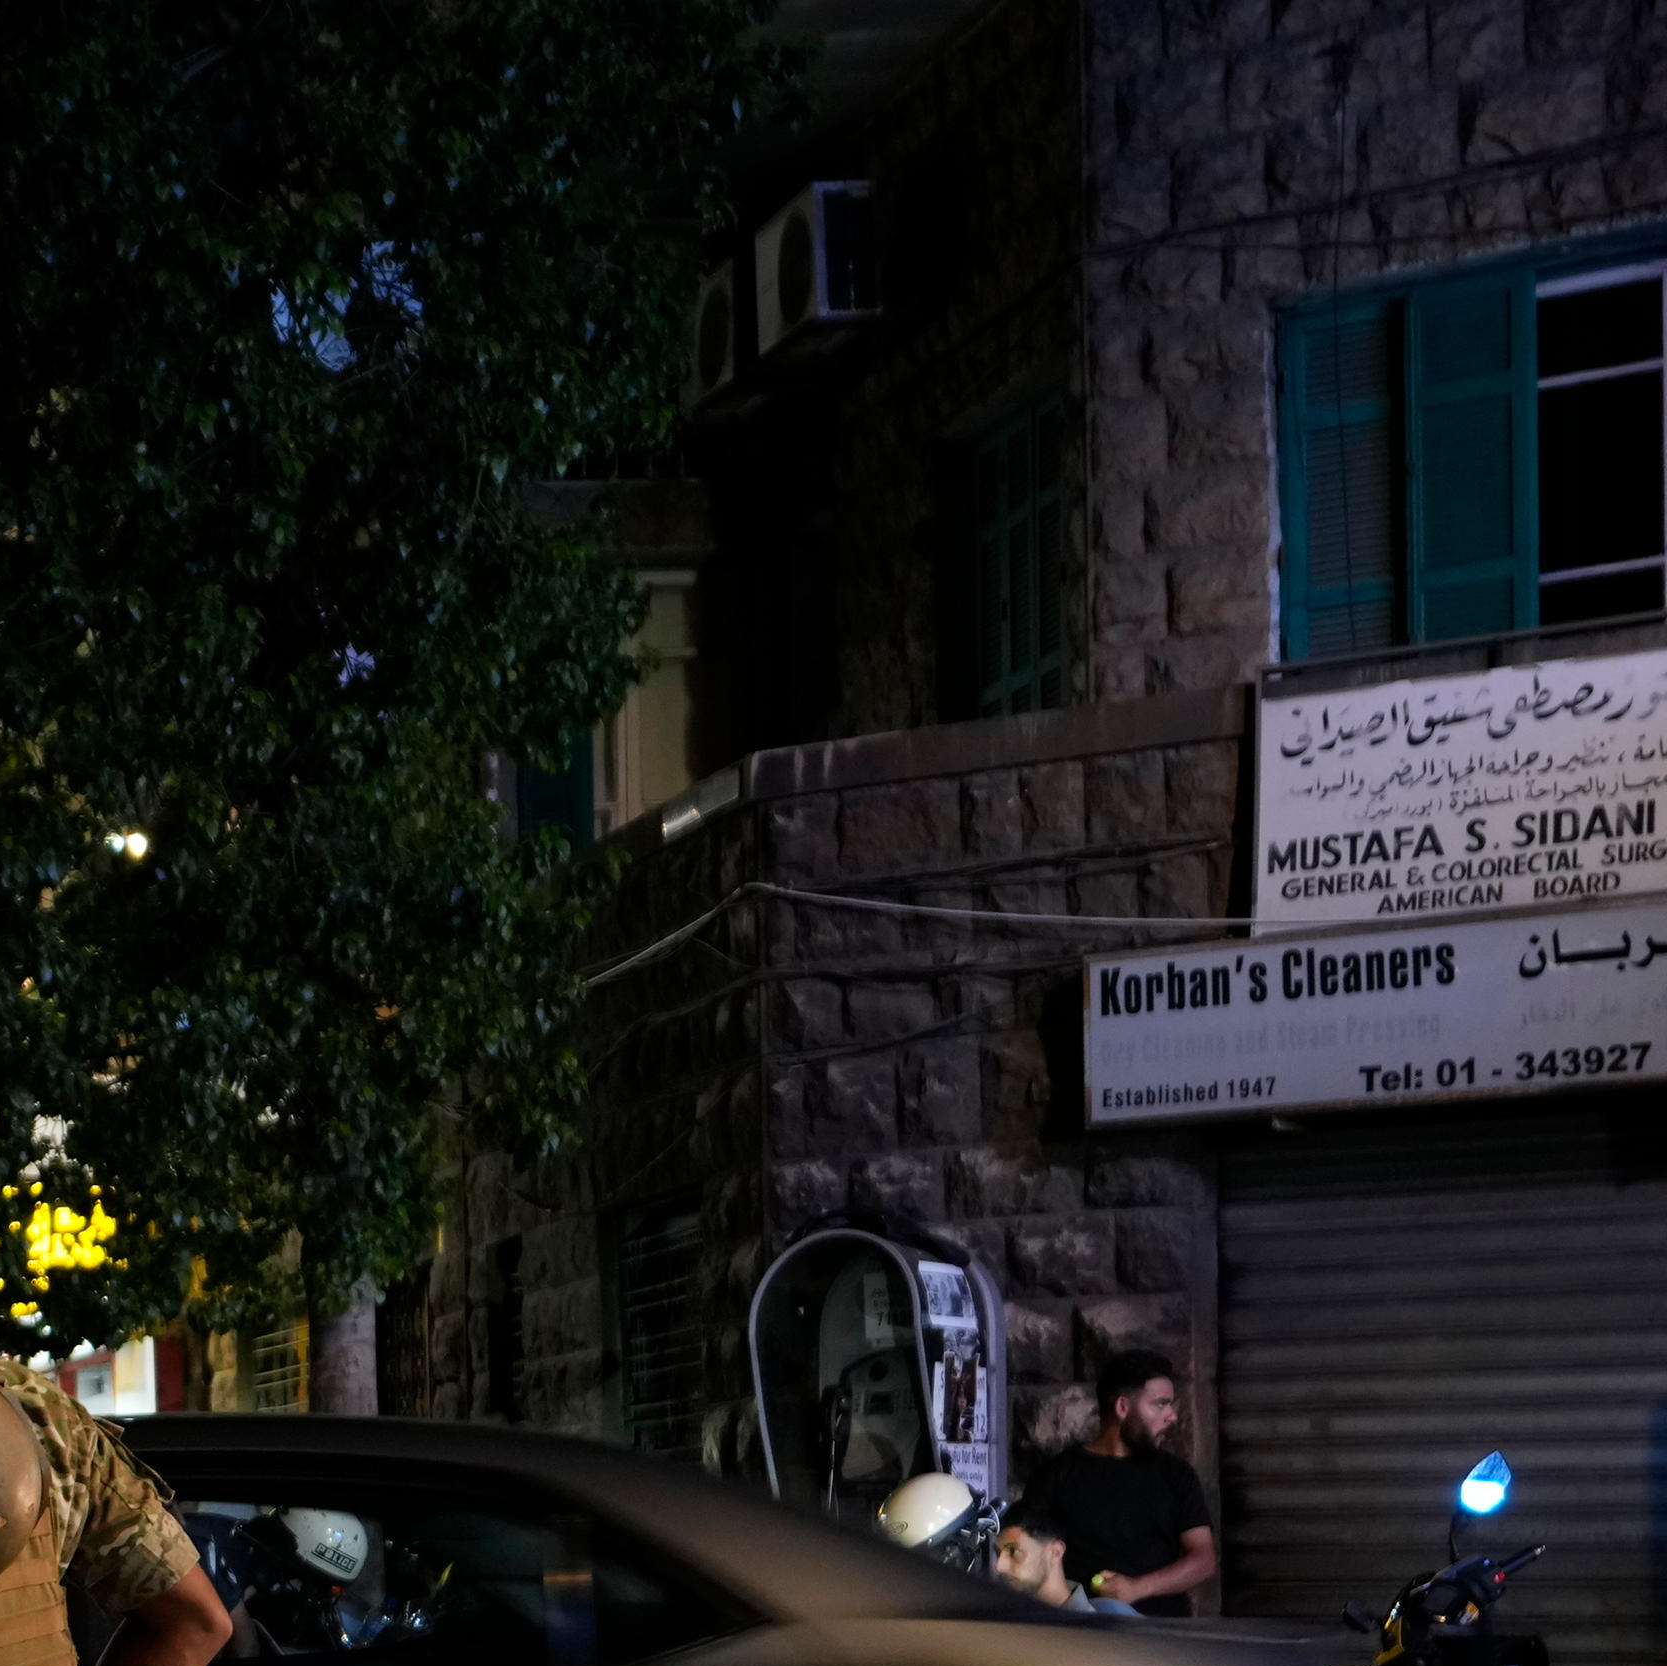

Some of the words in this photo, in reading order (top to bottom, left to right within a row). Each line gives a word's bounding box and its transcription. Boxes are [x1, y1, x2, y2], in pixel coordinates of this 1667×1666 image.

[1267, 823, 1444, 875] MUSTAFA
[1466, 817, 1500, 853] S.
[1511, 799, 1657, 848] SIDANI
[1281, 868, 1398, 900] GENERAL
[1406, 865, 1425, 886] &
[1432, 850, 1583, 883] COLORECTAL
[1376, 884, 1504, 915] AMERICAN
[1534, 871, 1622, 900] BOARD
[1100, 954, 1269, 1017] Korban's
[1281, 942, 1456, 1002] Cleaners
[1102, 1078, 1219, 1109] Established
[1226, 1075, 1277, 1100] 1947
[1359, 1063, 1424, 1094] Tel:
[1436, 1059, 1476, 1089] 01
[1515, 1041, 1653, 1081] 343927
